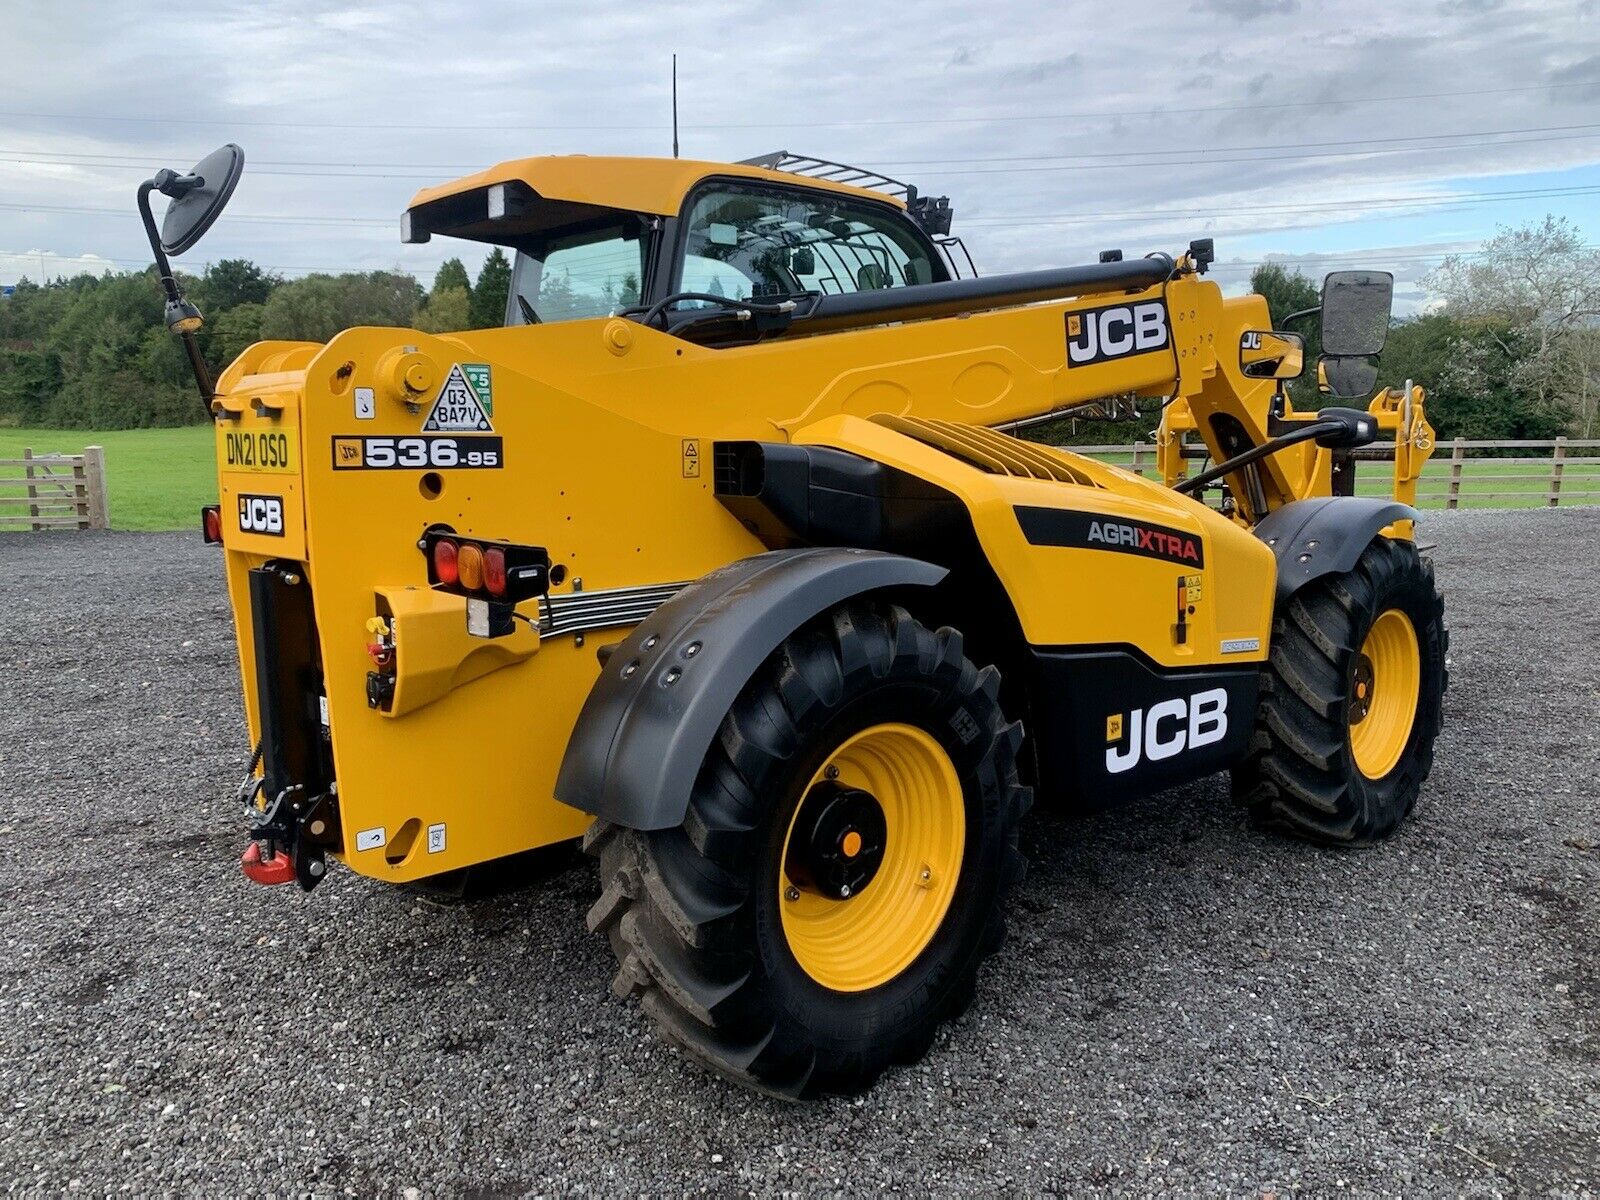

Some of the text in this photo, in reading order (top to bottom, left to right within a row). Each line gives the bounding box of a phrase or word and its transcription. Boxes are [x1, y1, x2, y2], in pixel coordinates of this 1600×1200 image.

[1069, 302, 1168, 363] JCB
[479, 373, 489, 387] 5
[438, 406, 477, 423] BA7V
[240, 498, 282, 534] JCB
[1087, 521, 1199, 561] AGRIXTRA
[1105, 687, 1228, 774] JCB
